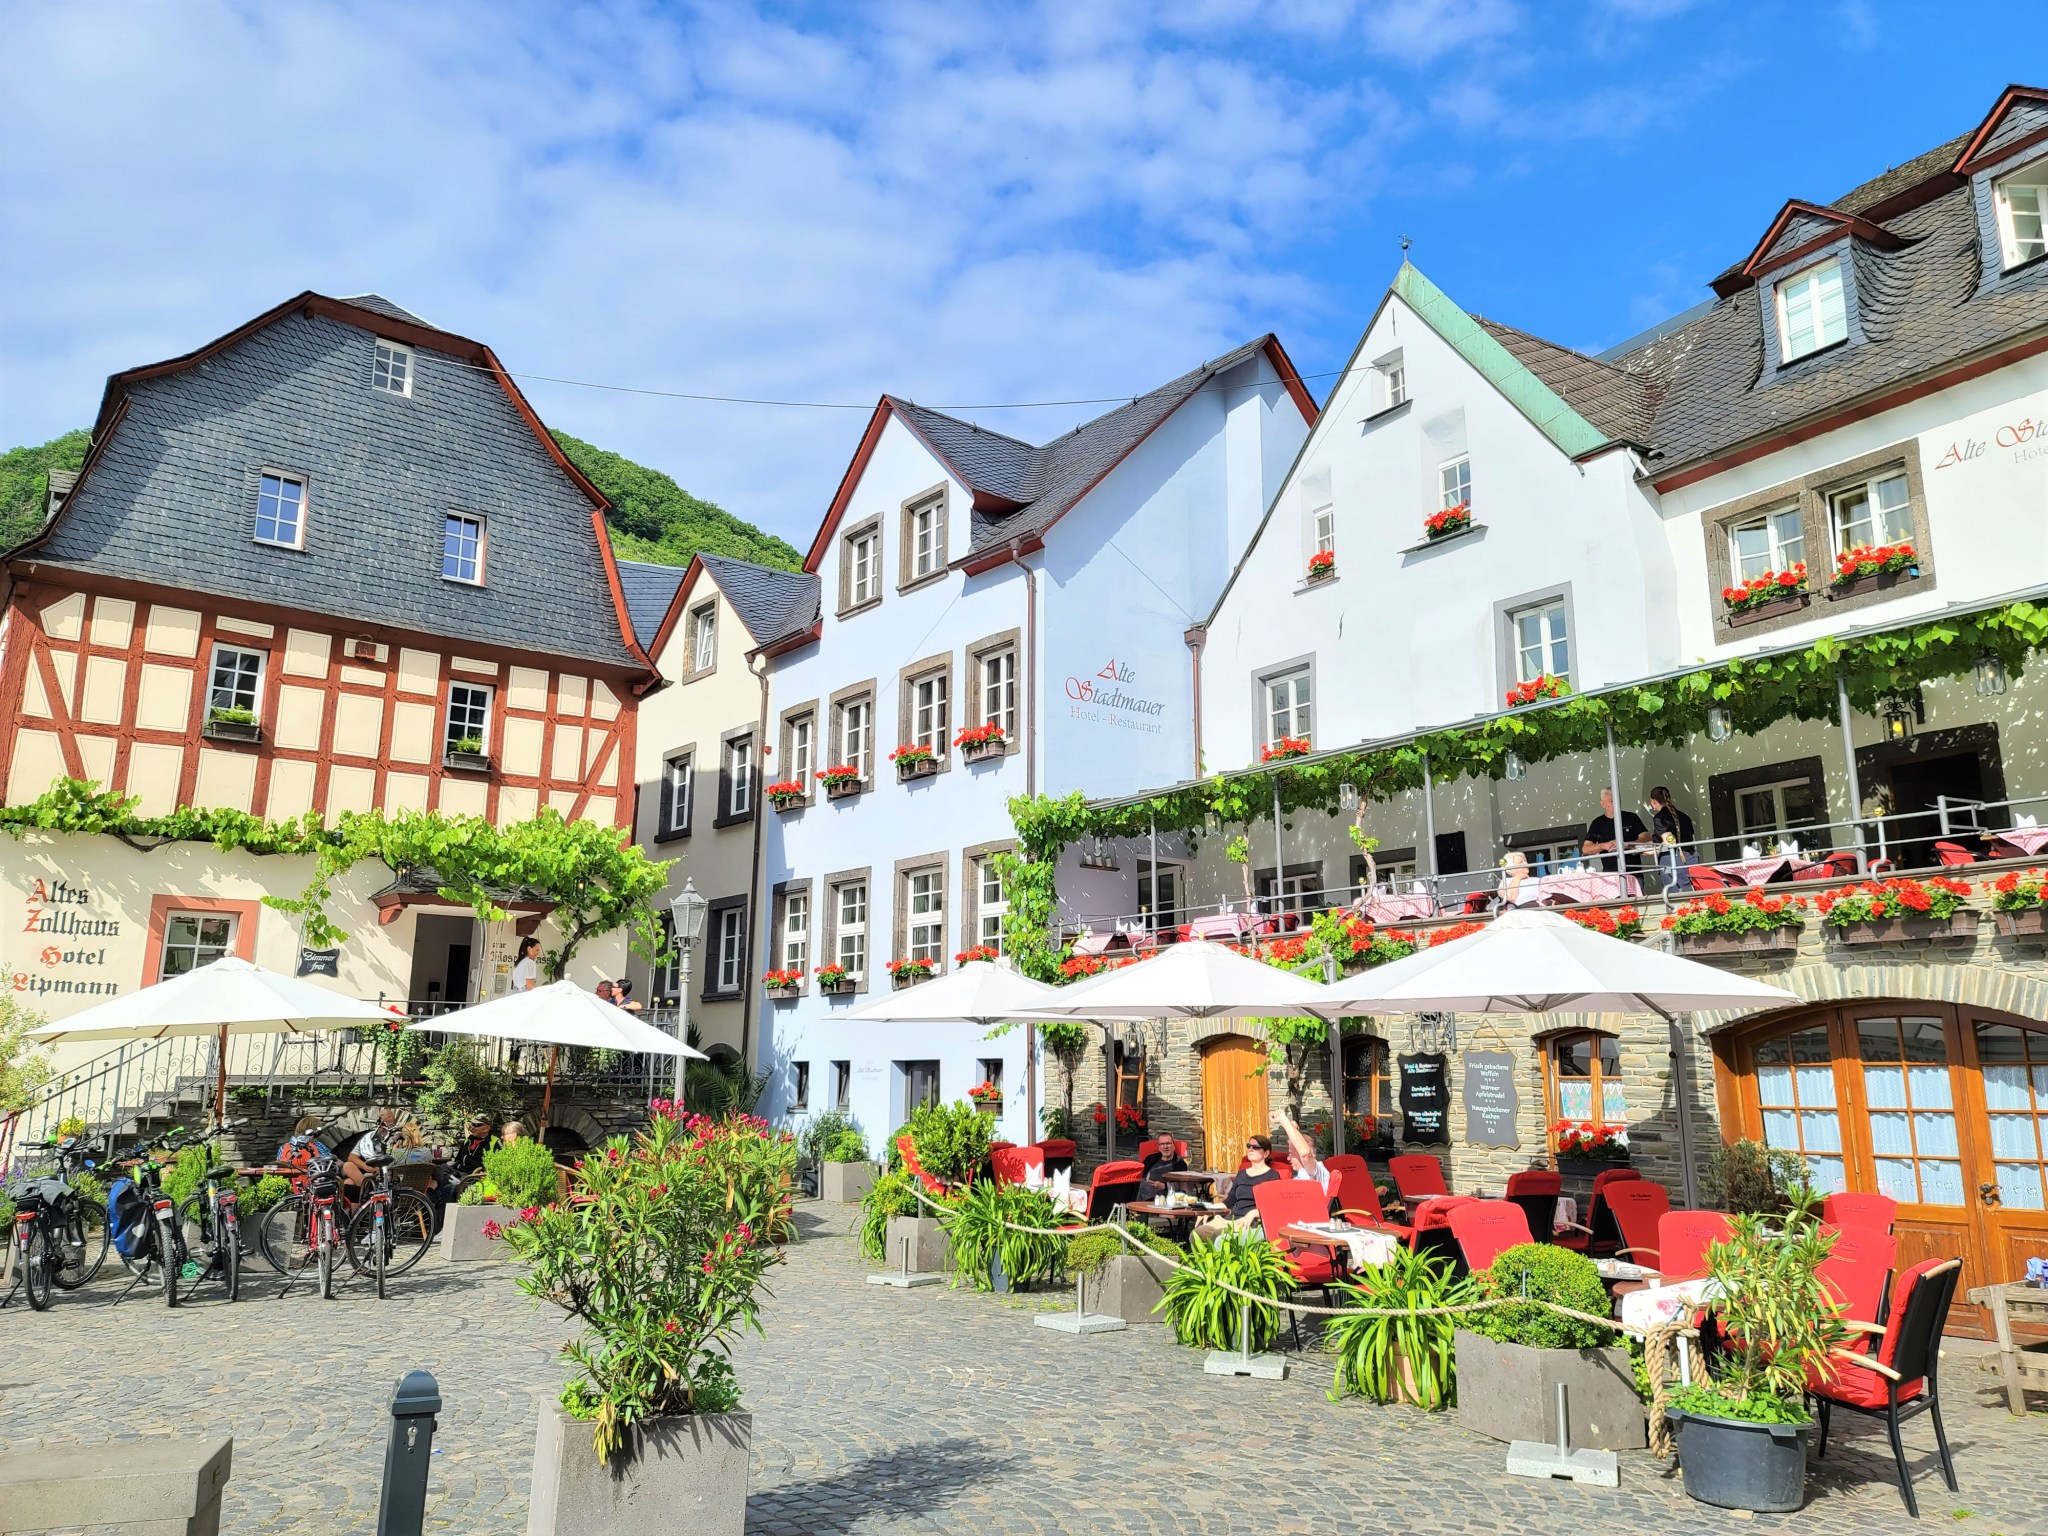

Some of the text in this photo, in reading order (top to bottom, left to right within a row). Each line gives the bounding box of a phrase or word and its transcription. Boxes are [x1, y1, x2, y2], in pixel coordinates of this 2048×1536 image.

[1934, 438, 1986, 470] Alte
[1097, 658, 1135, 684] Alte
[1065, 676, 1165, 716] Stadtmauer
[1070, 705, 1100, 723] Hotel
[1109, 713, 1162, 734] Restaurant
[25, 877, 90, 905] Altes
[22, 908, 121, 942] Zollhaus
[39, 945, 107, 969] Hotel
[11, 972, 119, 998] Lipmann
[1469, 1062, 1484, 1070] Frisch
[1481, 1112, 1501, 1120] Kuchen
